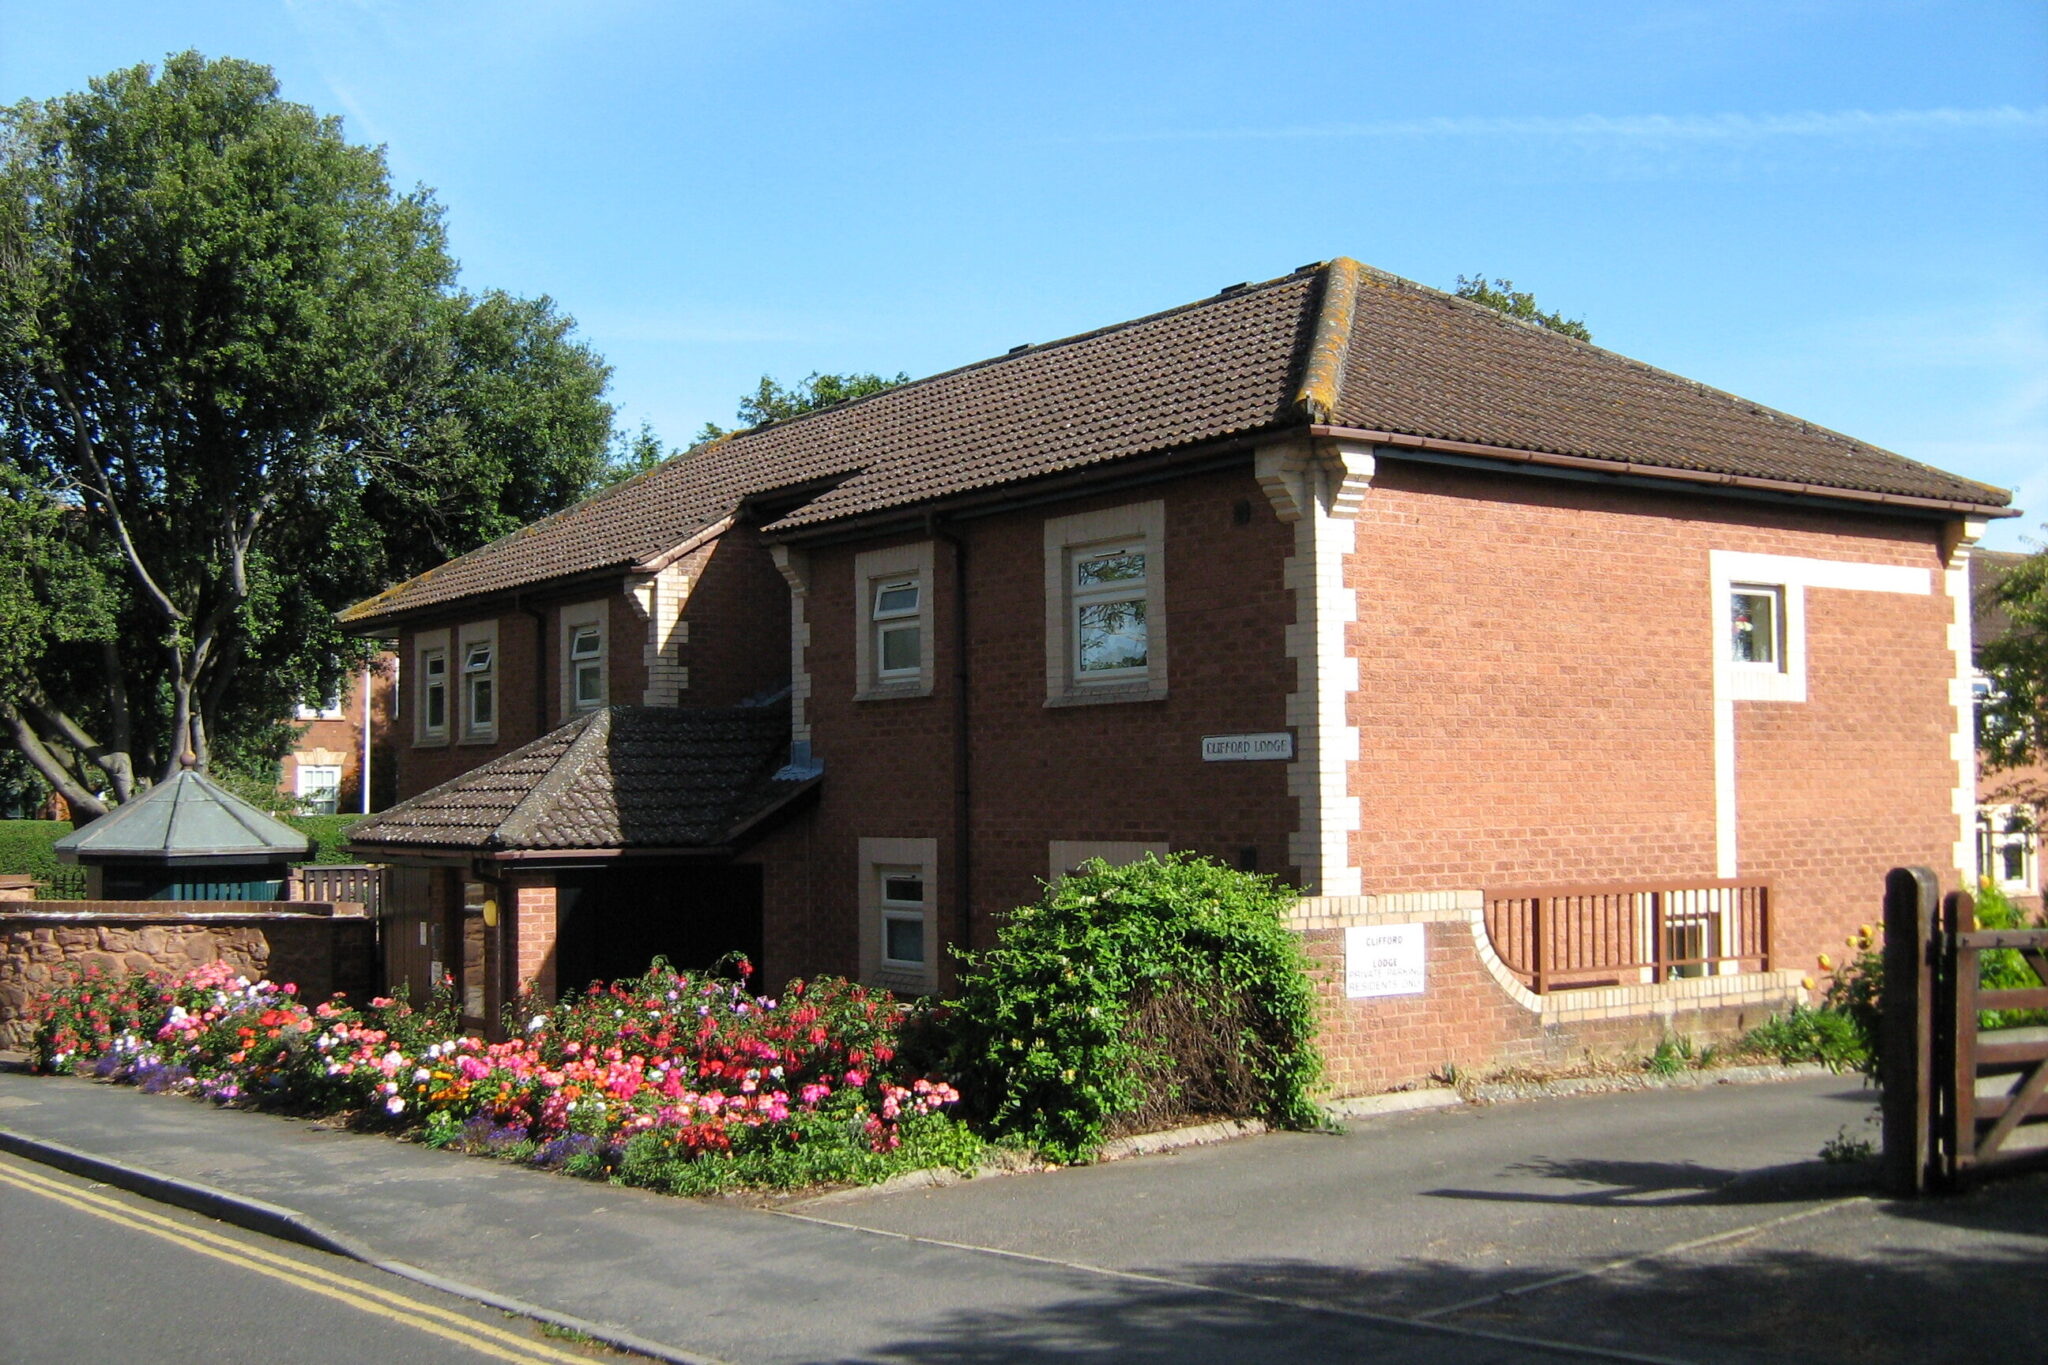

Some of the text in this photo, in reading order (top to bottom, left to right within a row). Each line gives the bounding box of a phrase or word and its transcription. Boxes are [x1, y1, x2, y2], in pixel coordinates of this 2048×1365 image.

[1206, 740, 1287, 754] CLIFFORD LODGE
[1366, 935, 1403, 947] CLIFFORD
[1373, 958, 1398, 968] LODGE
